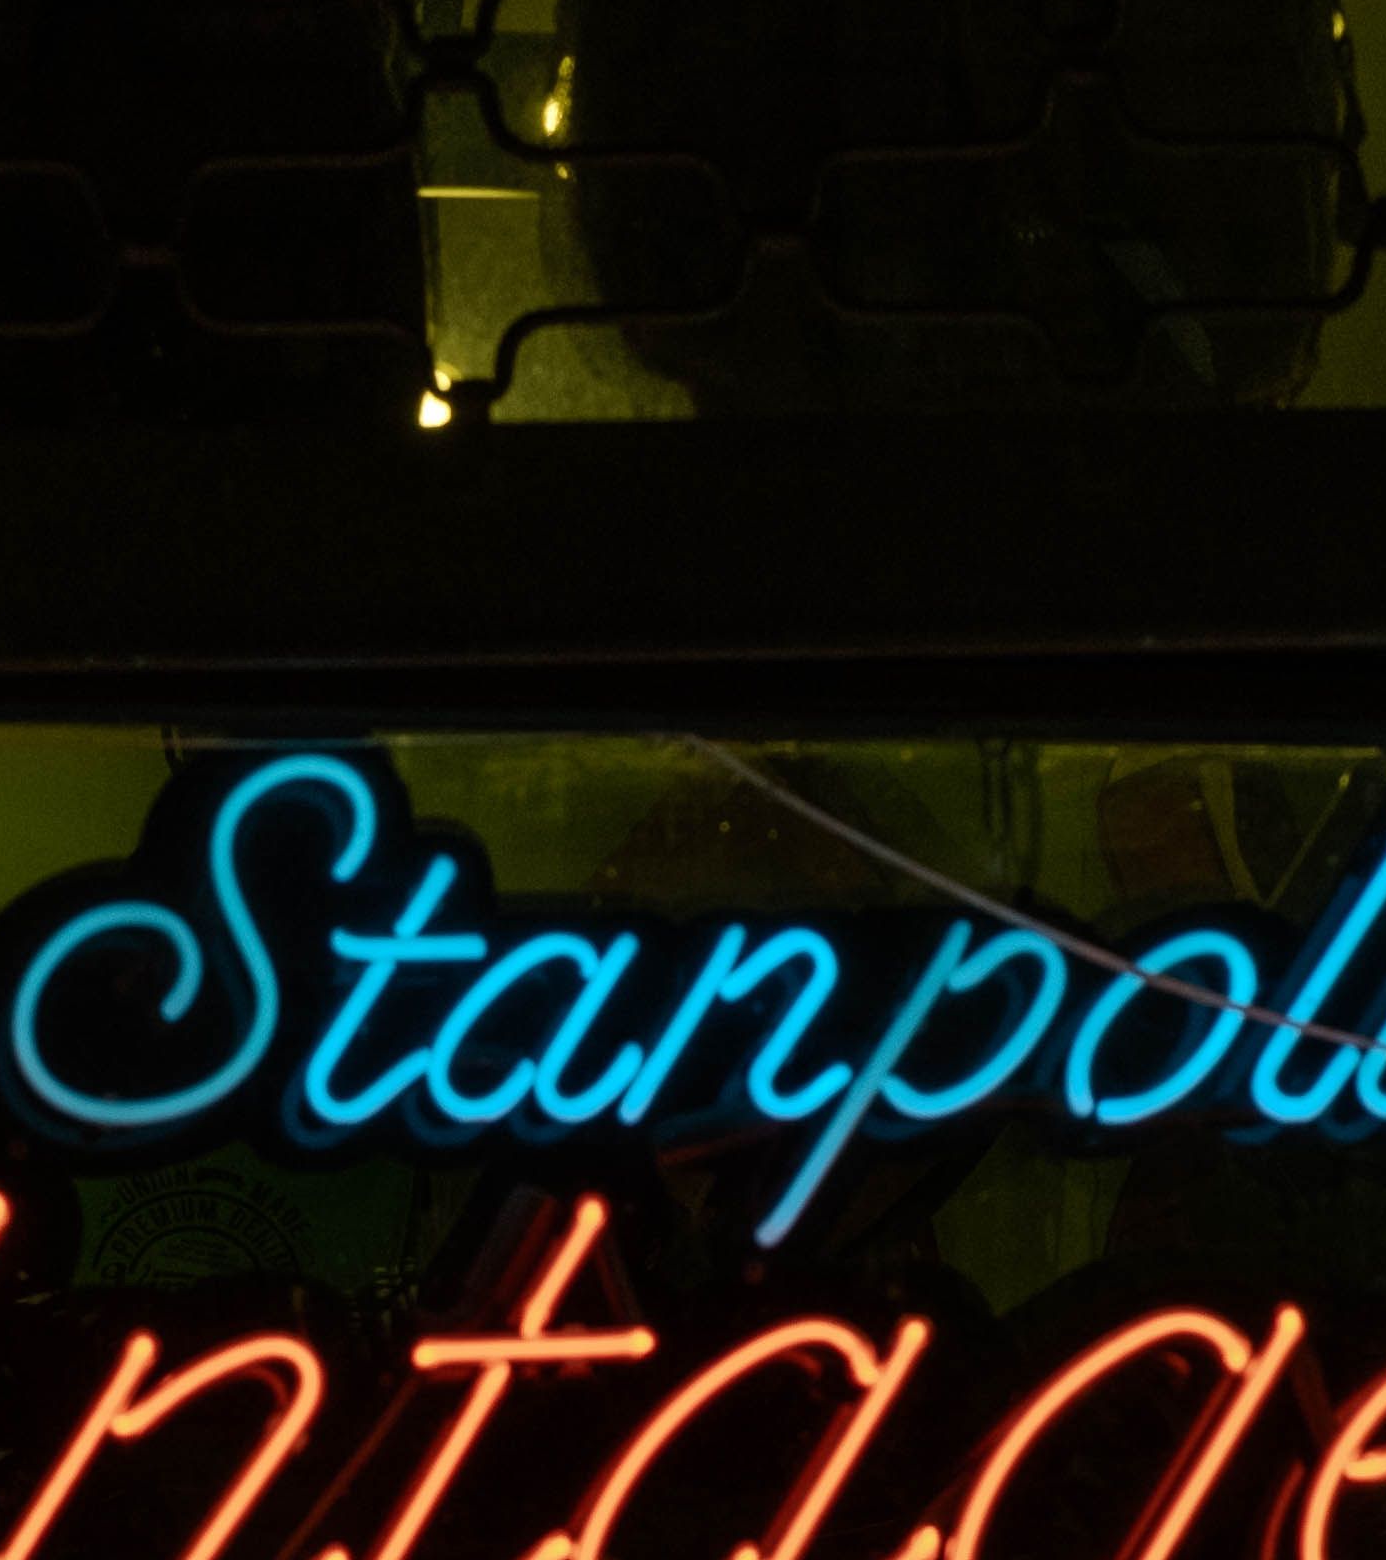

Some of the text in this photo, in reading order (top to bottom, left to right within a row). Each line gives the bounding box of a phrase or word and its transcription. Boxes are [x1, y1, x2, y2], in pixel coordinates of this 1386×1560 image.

[111, 1197, 219, 1258] PREMIUM
[117, 1165, 313, 1238] UNION MADE
